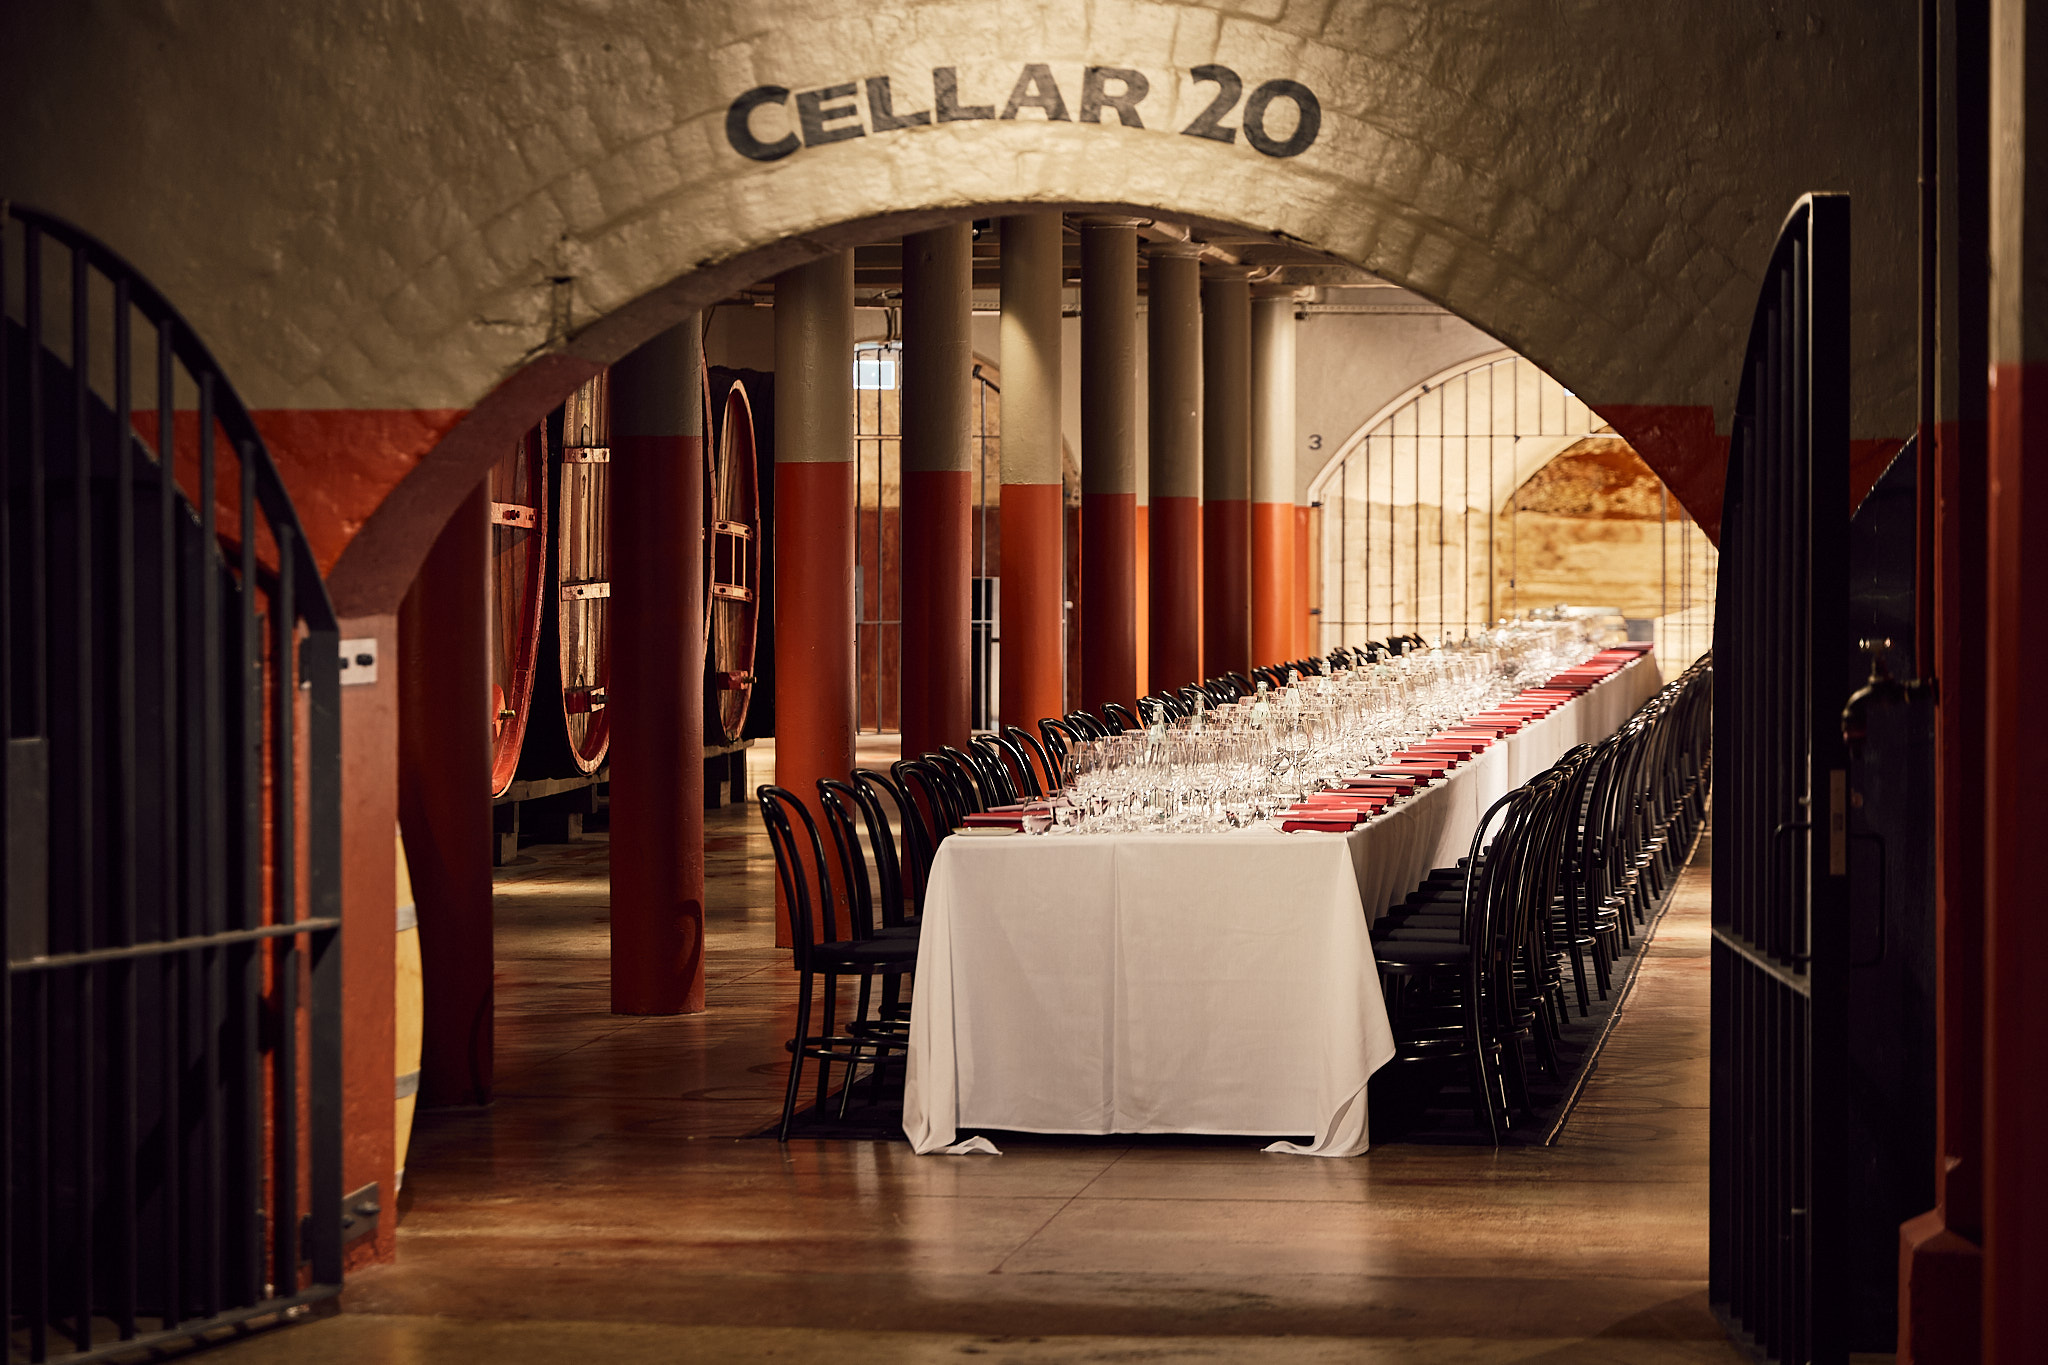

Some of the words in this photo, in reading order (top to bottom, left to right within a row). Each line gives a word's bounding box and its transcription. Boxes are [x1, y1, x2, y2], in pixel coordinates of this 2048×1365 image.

[725, 63, 1150, 162] CELLAR
[1180, 63, 1322, 159] 20
[1308, 433, 1322, 450] 3
